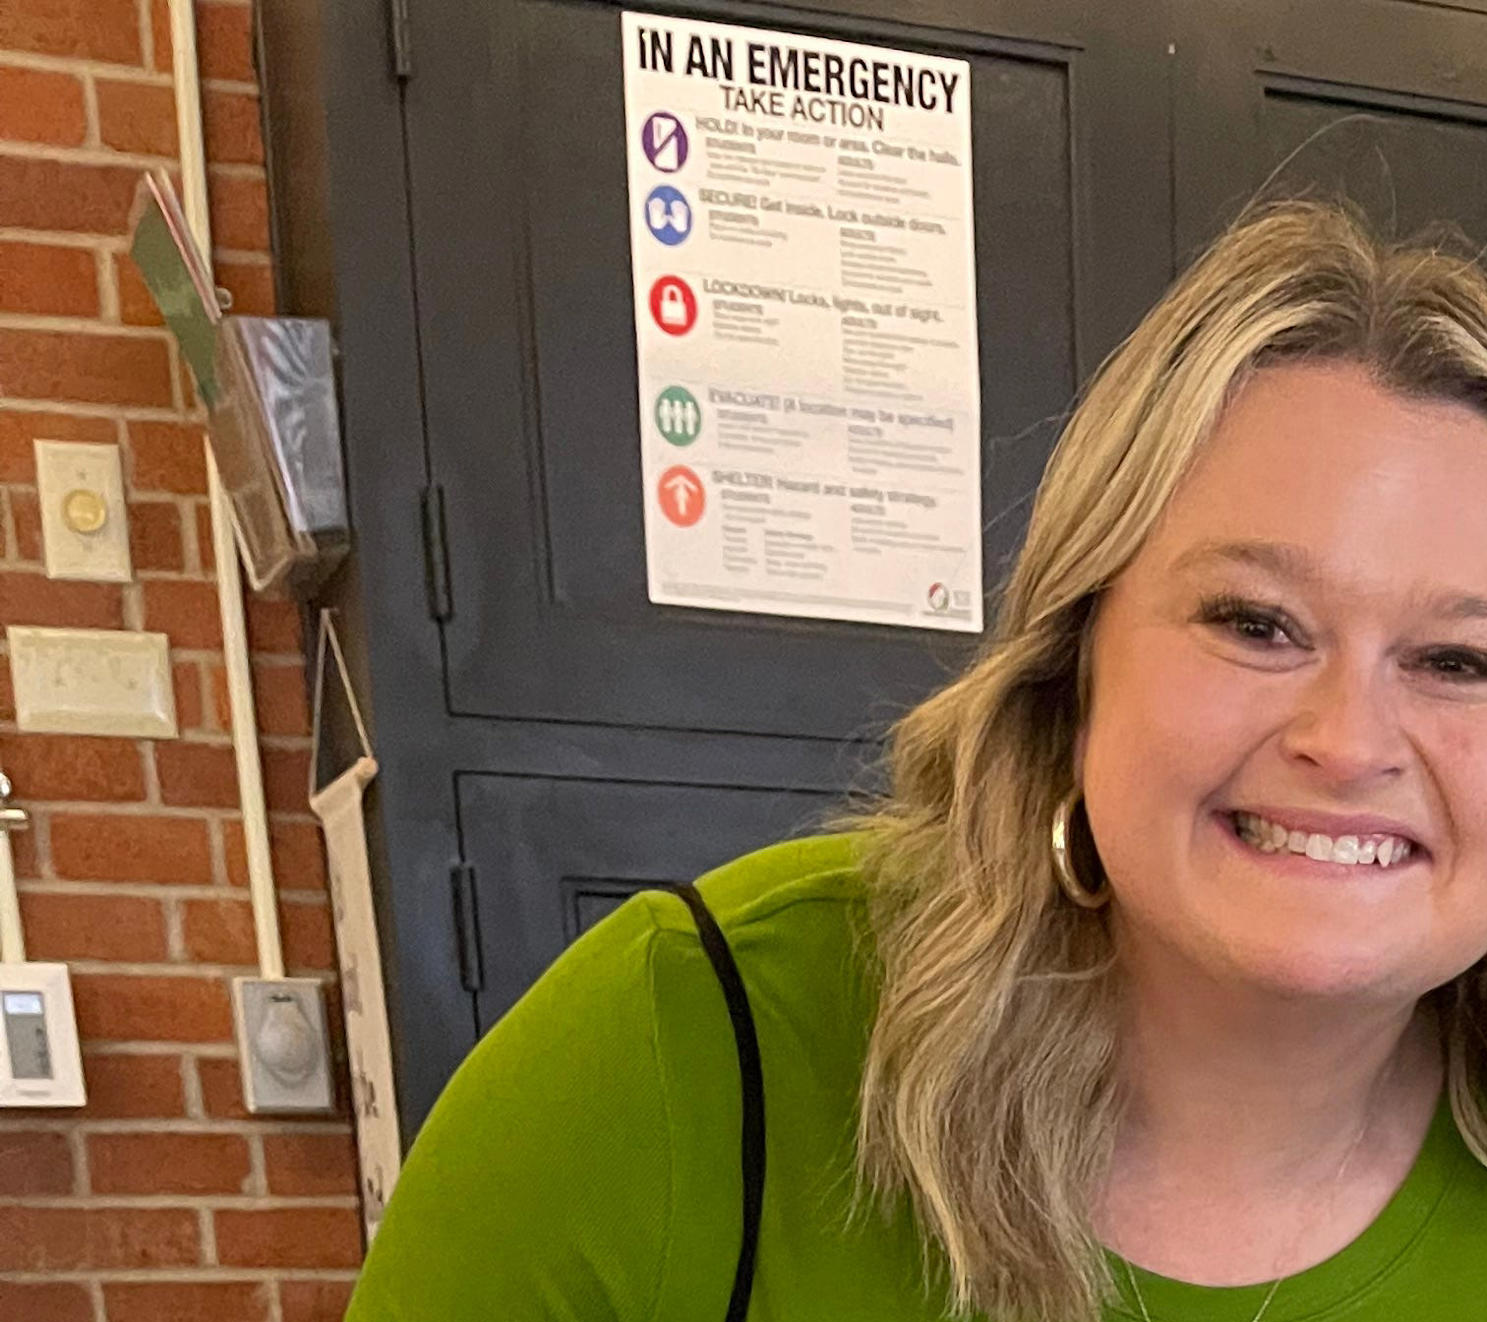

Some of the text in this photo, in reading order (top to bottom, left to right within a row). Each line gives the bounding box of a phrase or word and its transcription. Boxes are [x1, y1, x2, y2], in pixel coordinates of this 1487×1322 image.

[638, 26, 958, 114] IN AN EMERGENCY
[719, 85, 884, 133] TAKE ACTION
